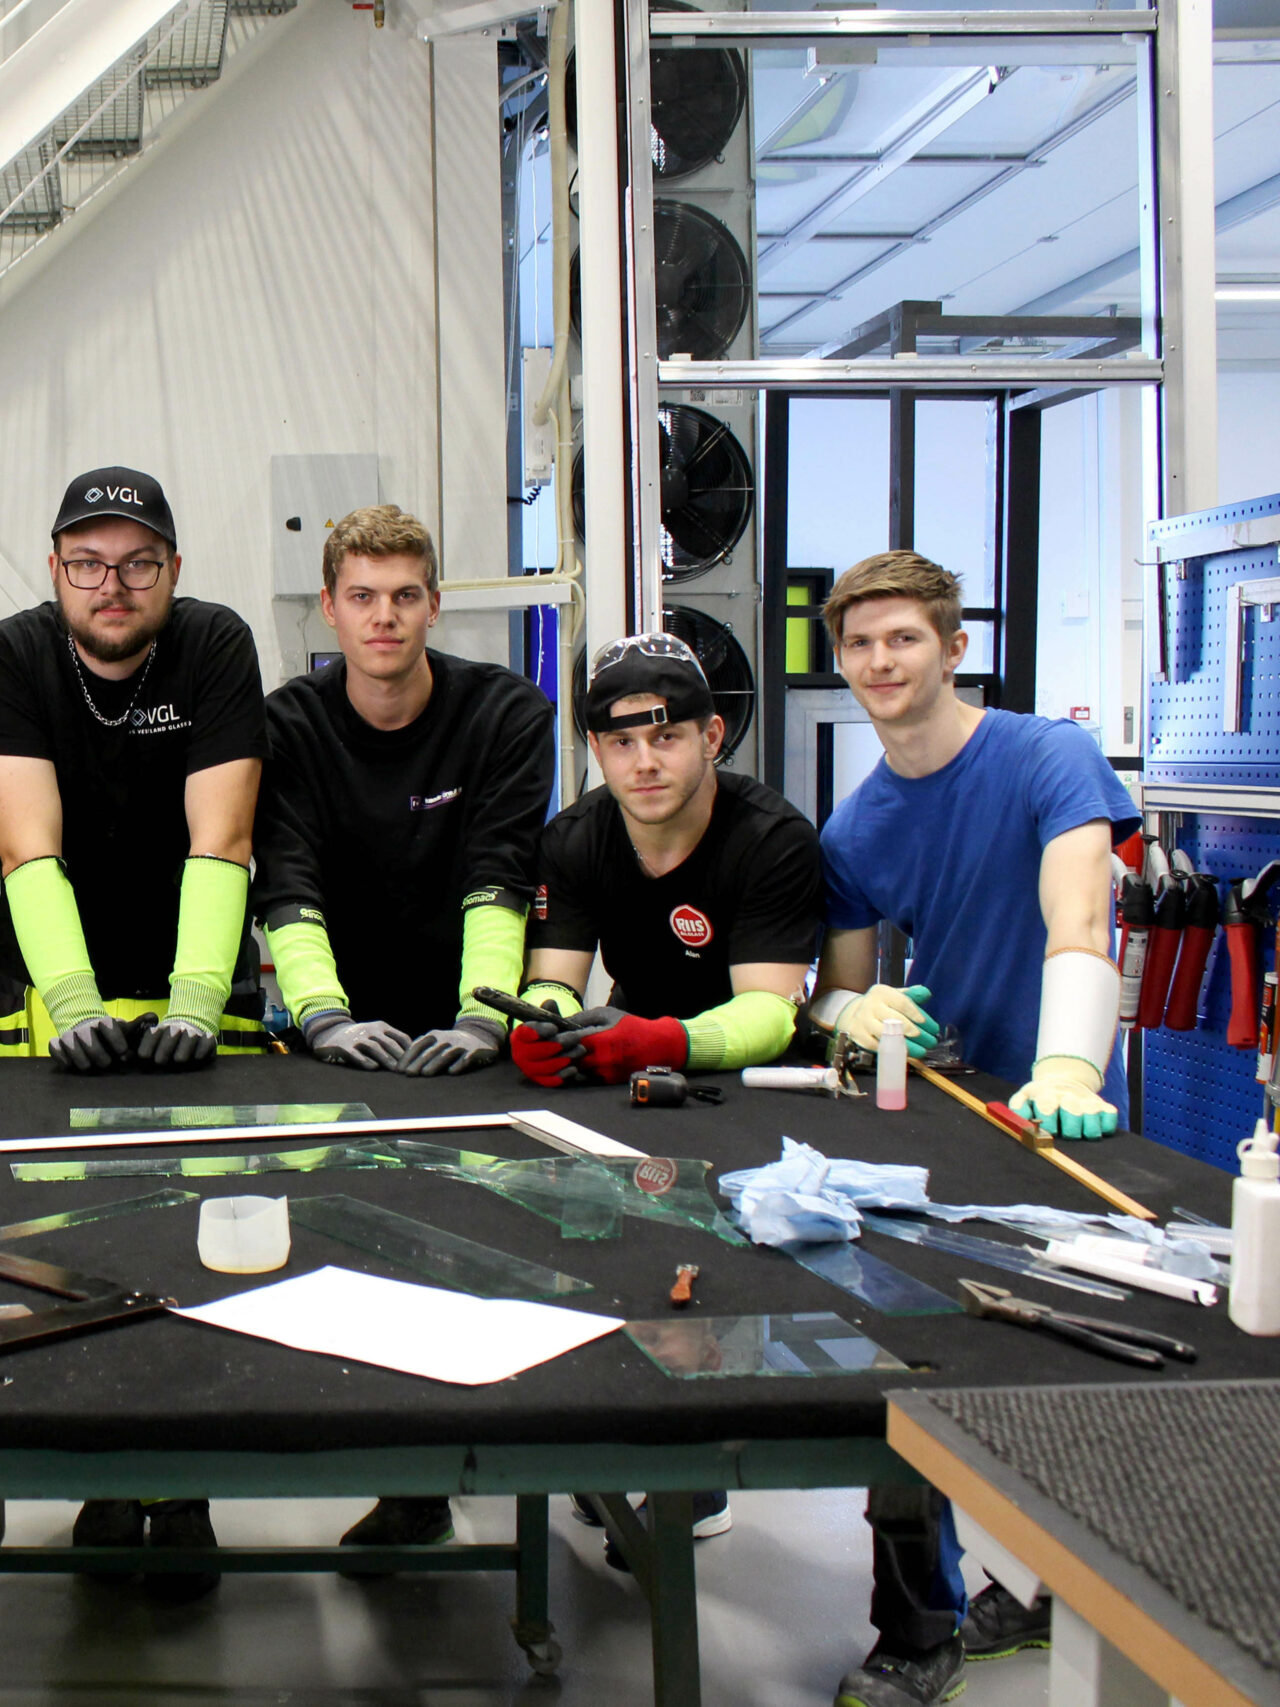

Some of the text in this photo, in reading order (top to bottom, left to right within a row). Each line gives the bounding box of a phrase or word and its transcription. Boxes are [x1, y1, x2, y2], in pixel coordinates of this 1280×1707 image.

[106, 485, 144, 506] VGL
[147, 703, 181, 725] VGL
[675, 917, 705, 932] RIIS
